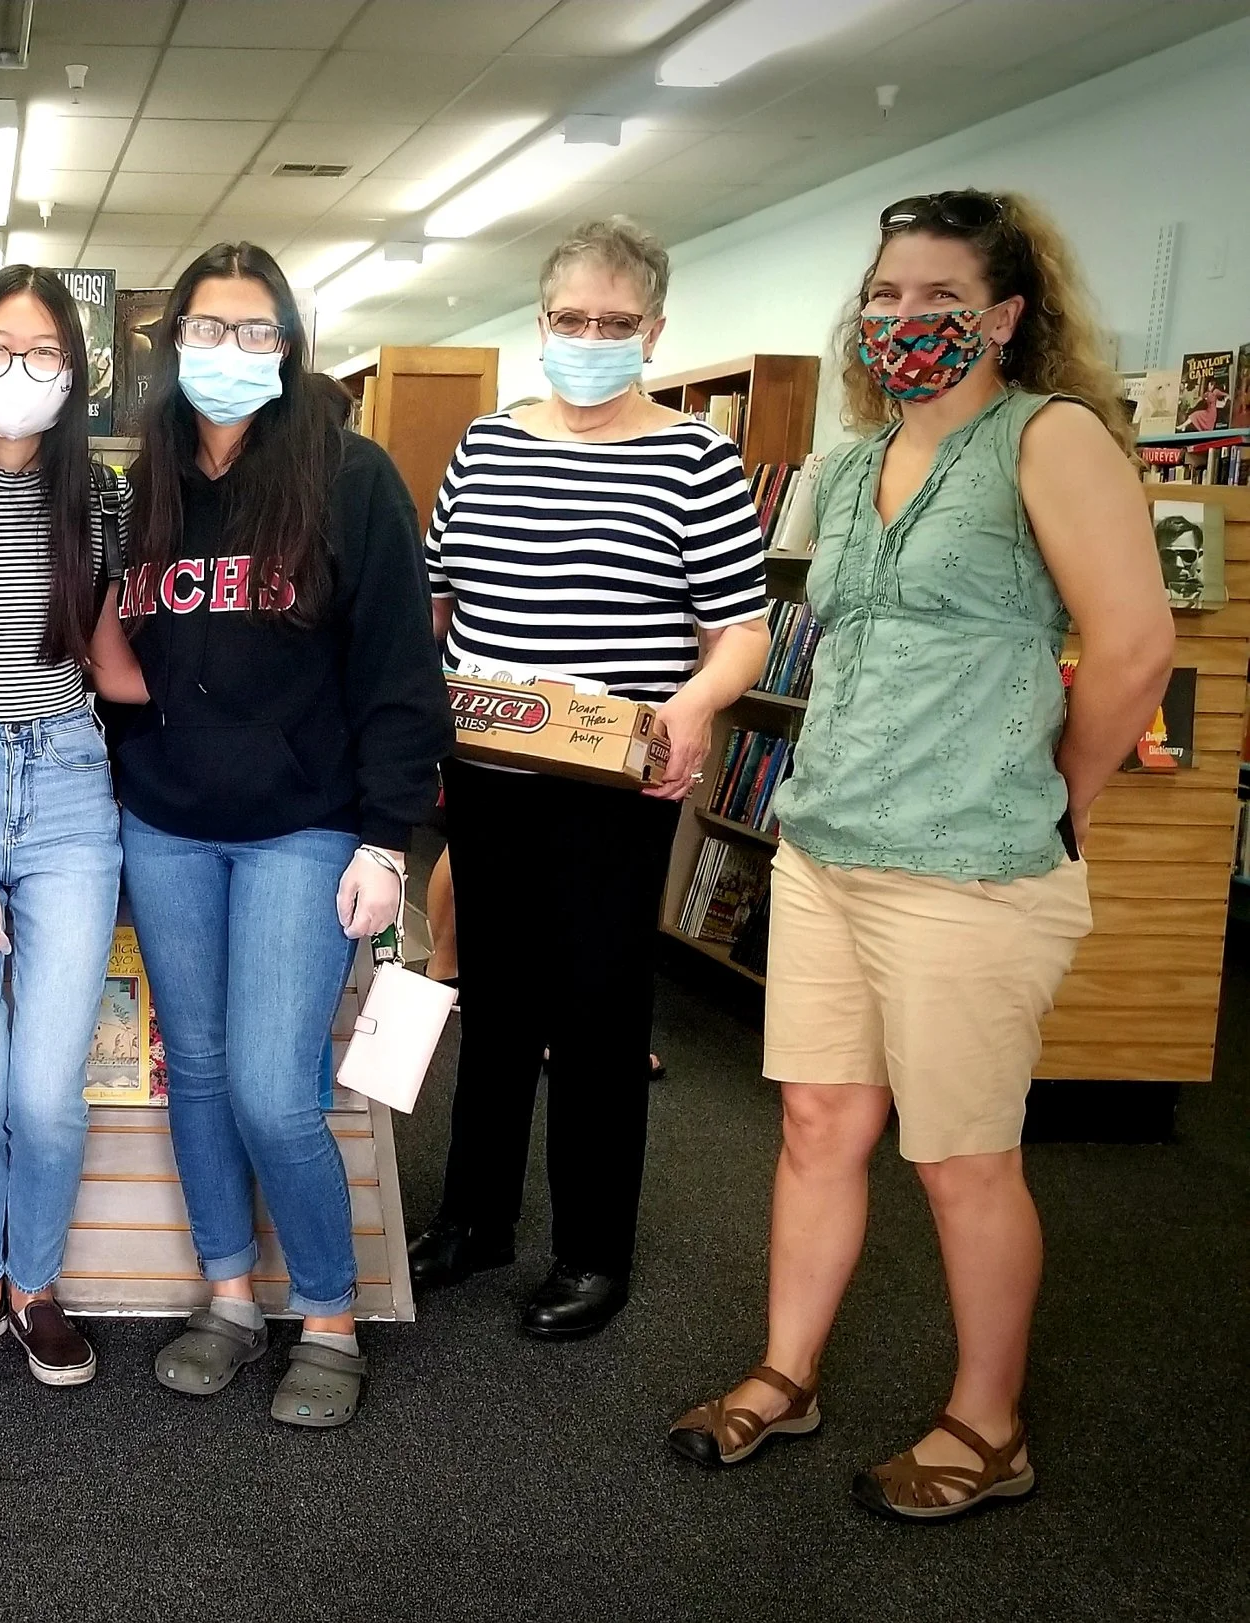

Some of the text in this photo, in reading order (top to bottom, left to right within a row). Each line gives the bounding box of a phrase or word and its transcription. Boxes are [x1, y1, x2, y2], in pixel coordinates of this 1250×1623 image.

[58, 272, 106, 307] UGOSI
[1190, 354, 1231, 370] HAYLOFT
[1189, 368, 1214, 380] GANG
[1142, 451, 1180, 463] NUREYEV
[119, 555, 296, 619] MCHS
[569, 730, 603, 753] AWAY
[1149, 744, 1183, 758] Dictionary
